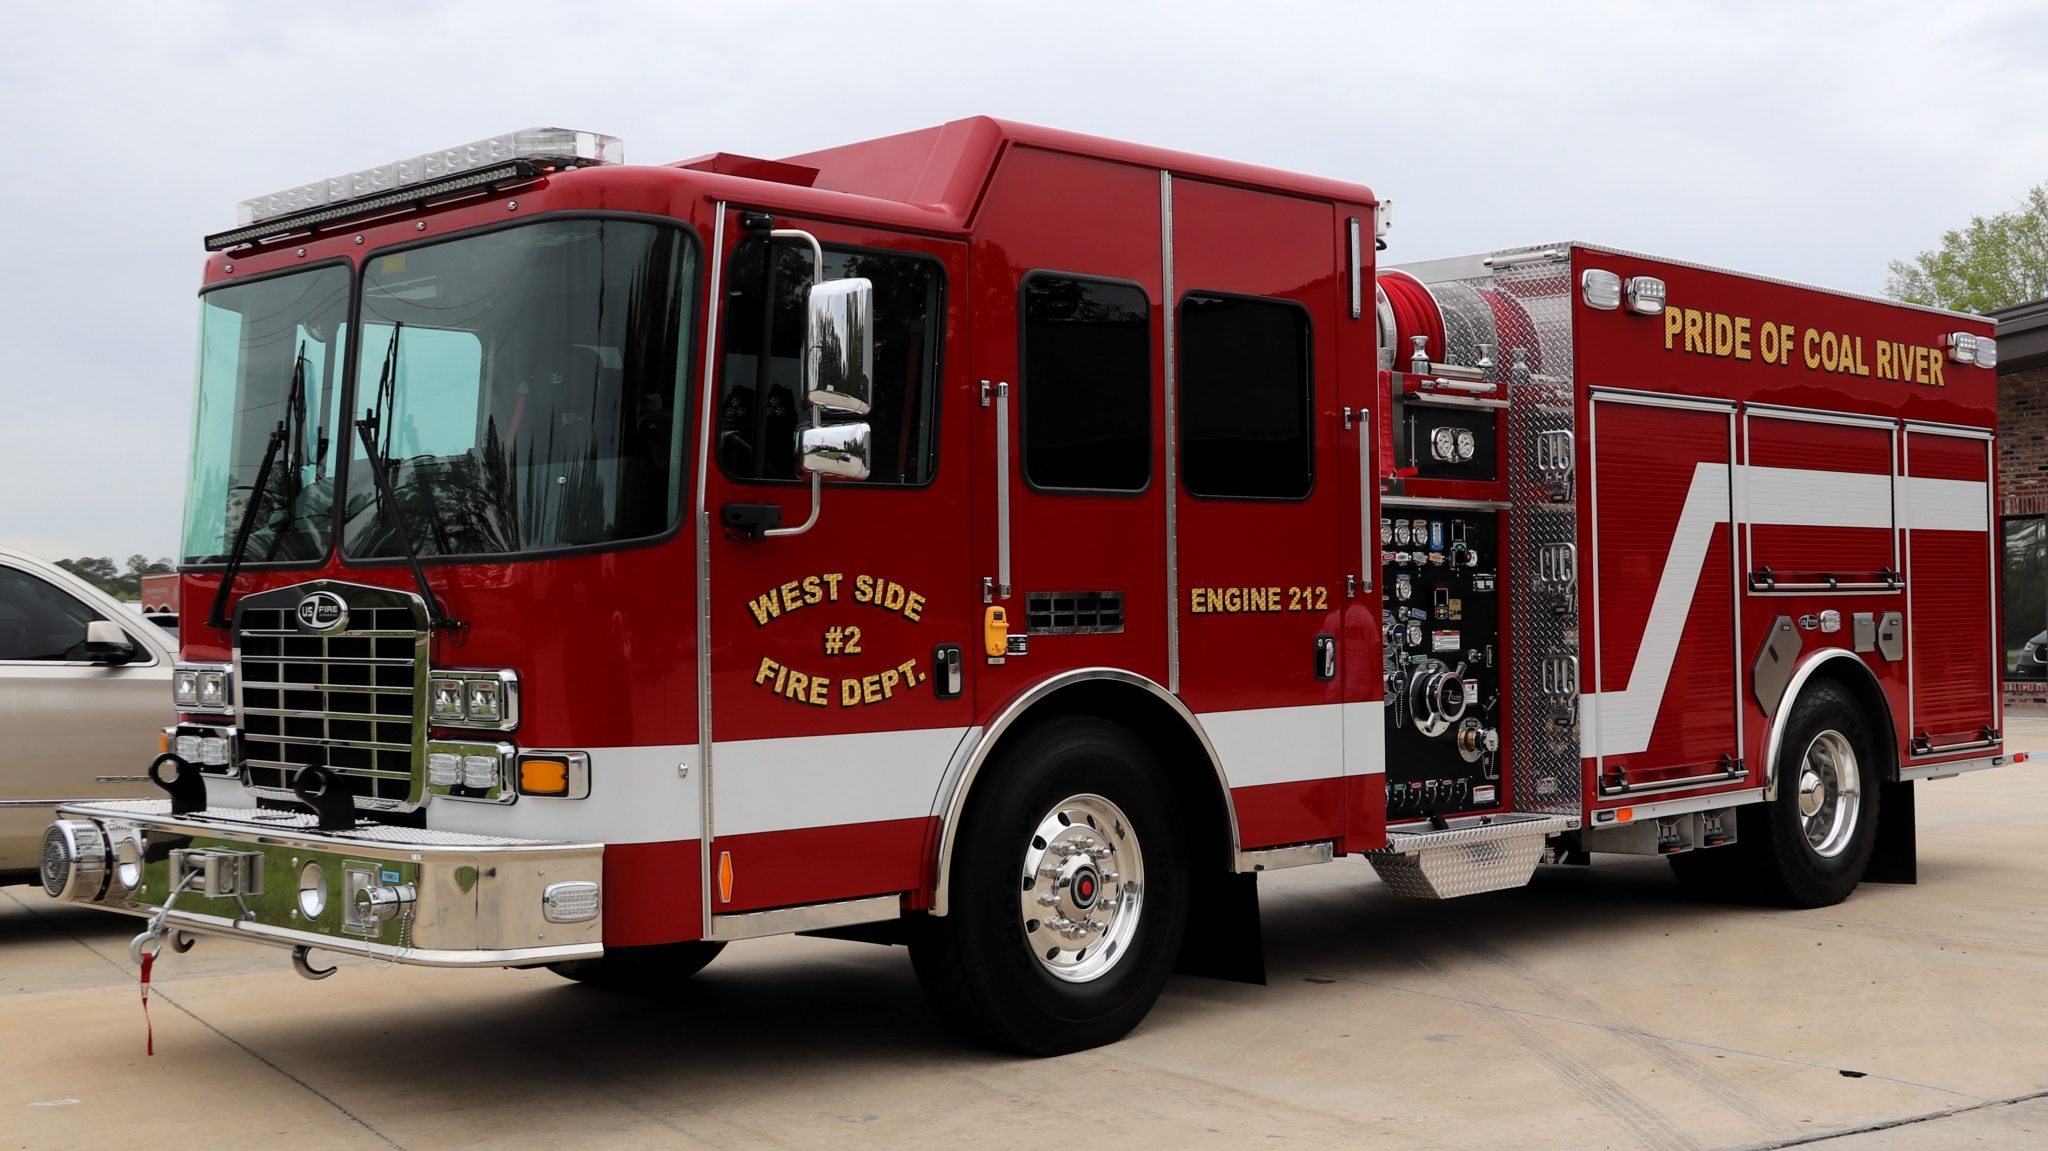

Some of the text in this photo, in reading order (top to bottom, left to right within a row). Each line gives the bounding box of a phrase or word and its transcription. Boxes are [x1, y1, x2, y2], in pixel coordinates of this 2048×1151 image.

[1664, 305, 1945, 386] PRIDE OF COAL RIVER
[302, 605, 338, 617] US FIRE
[749, 573, 926, 626] WEST SIDE
[1191, 586, 1328, 613] ENGINE 212
[825, 626, 862, 655] #2
[755, 657, 927, 706] FIRE DEPT.
